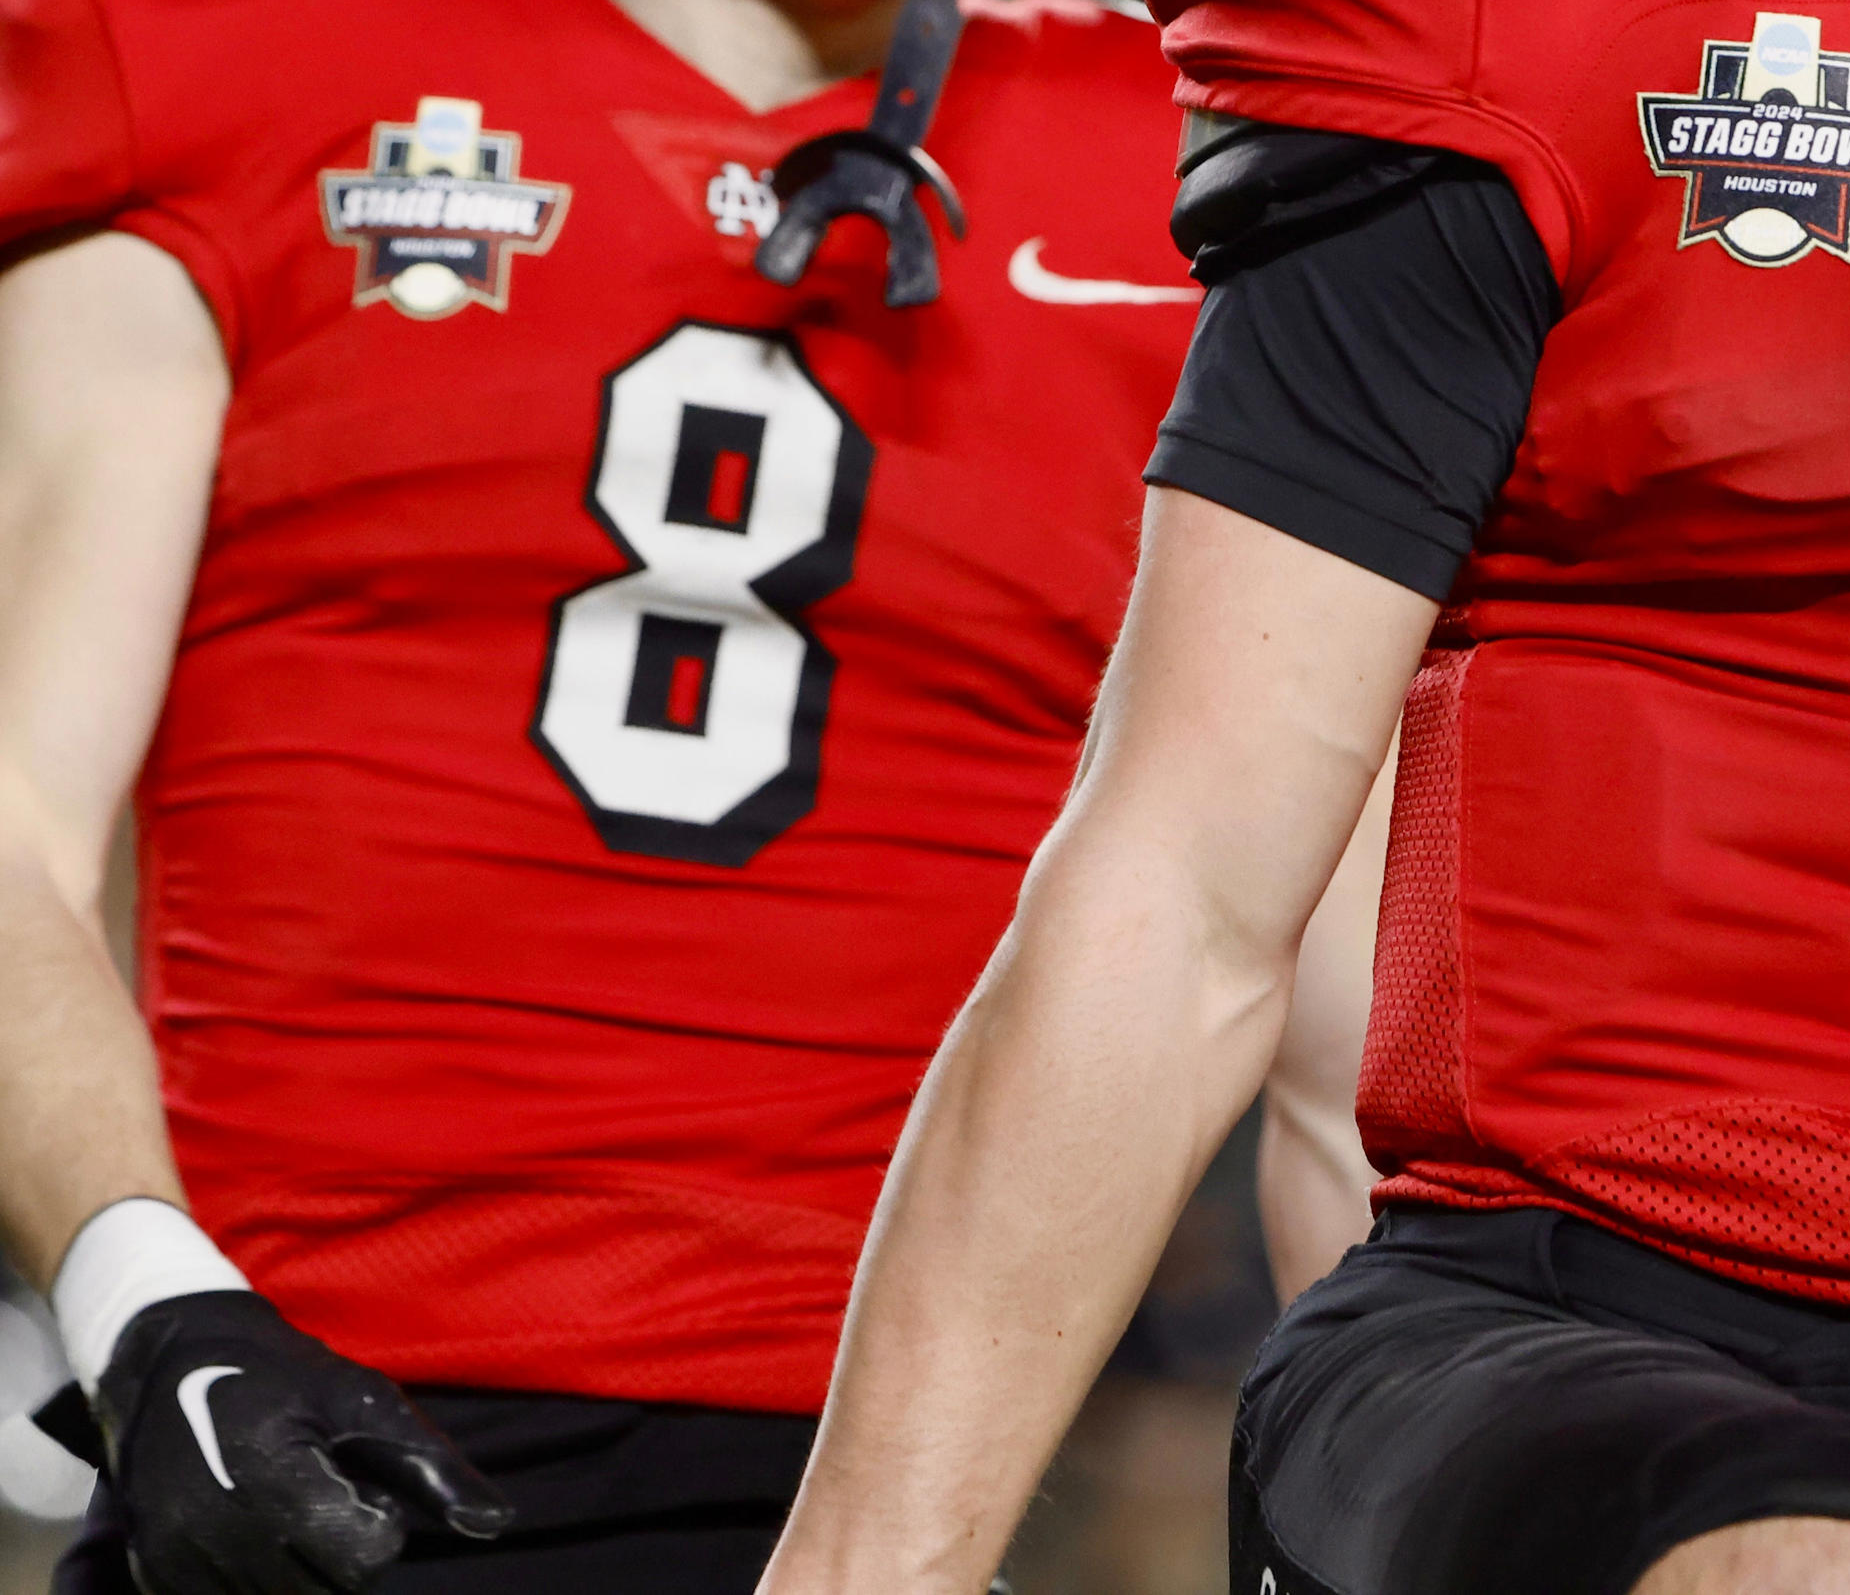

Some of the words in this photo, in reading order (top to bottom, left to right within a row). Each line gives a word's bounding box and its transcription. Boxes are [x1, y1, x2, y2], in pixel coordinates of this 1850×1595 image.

[1752, 103, 1806, 122] 2024
[1667, 116, 1783, 159] STAGG
[1723, 175, 1817, 198] HOUSTON
[532, 319, 875, 867] 8
